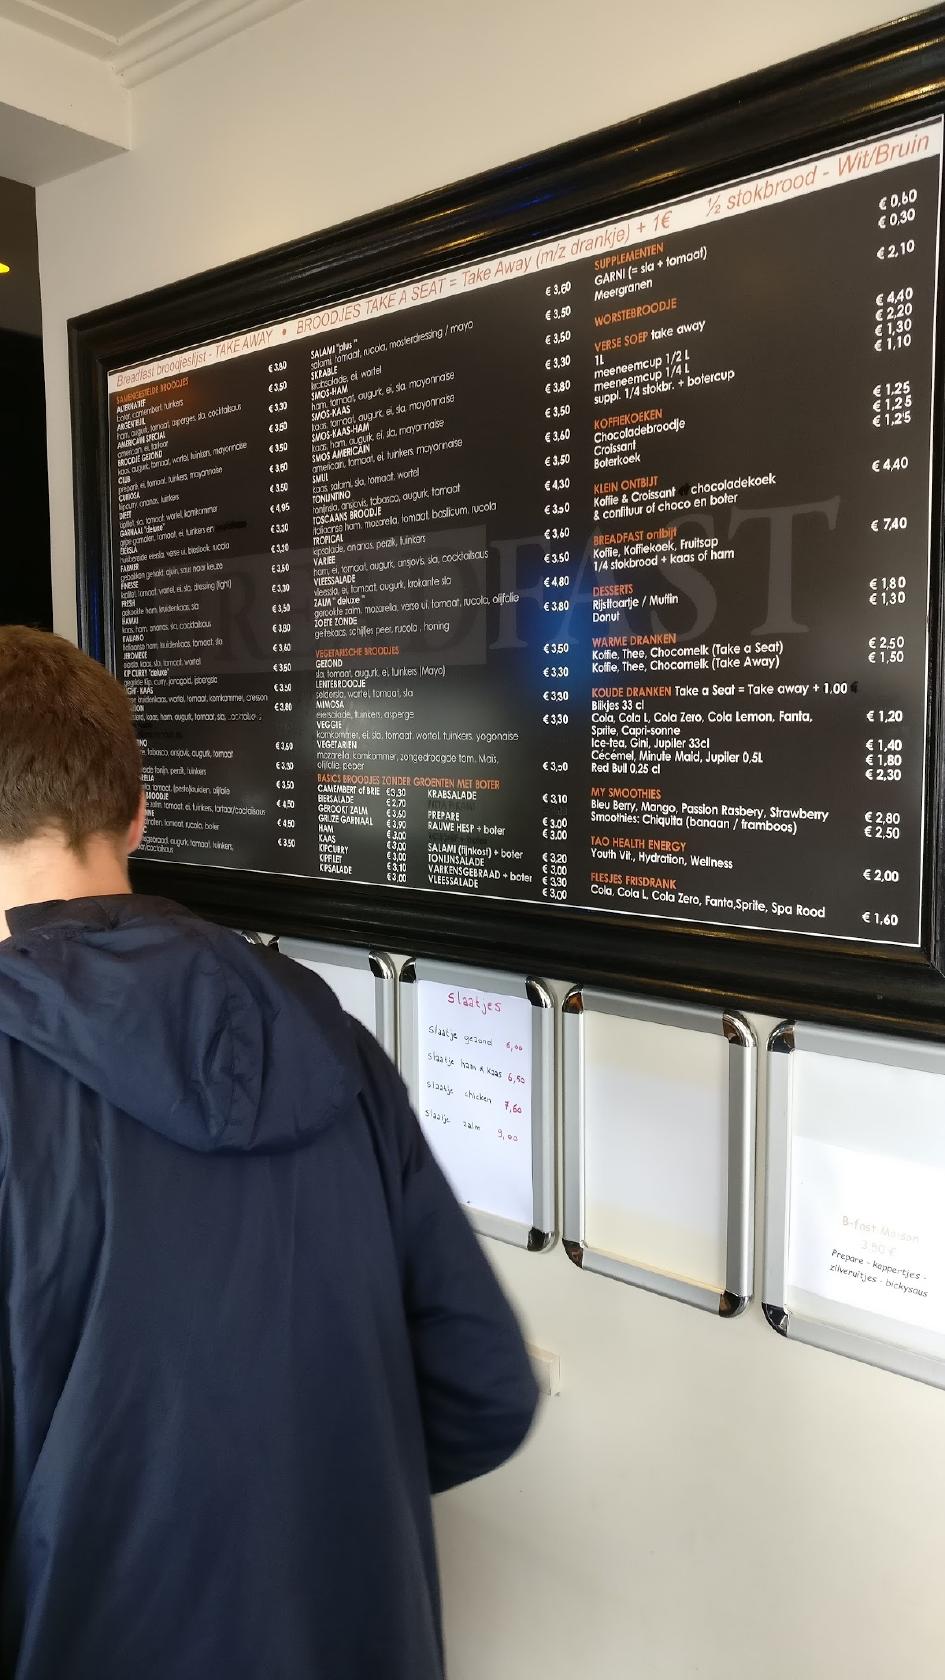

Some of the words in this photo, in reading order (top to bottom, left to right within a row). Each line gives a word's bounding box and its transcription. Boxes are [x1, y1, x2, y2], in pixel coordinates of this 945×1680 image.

[241, 328, 274, 351] AWAY
[295, 302, 362, 335] BROODJES
[364, 291, 397, 315] TAKE
[398, 289, 407, 306] A
[410, 277, 447, 302] SEAT
[461, 267, 492, 287] Take
[493, 255, 533, 278] Away
[535, 243, 567, 270] (m/z
[570, 223, 630, 256] drankje)
[653, 209, 673, 232] 1€
[726, 165, 818, 210] stokbrood
[838, 133, 929, 177] Wit/Bruin
[876, 246, 885, 260] €
[887, 239, 916, 259] 2,10
[594, 241, 664, 271] SUPPLEMENTEN
[594, 278, 653, 302] Meergranen
[875, 293, 884, 307] €
[886, 287, 914, 305] 4,40
[545, 309, 552, 321] €
[552, 305, 572, 320] 3,50
[594, 297, 677, 327] WORSTEBROODJE
[594, 337, 622, 352] VERSE
[624, 331, 649, 346] SOEP
[650, 327, 674, 341] take
[676, 320, 706, 335] away
[593, 408, 663, 430] KOFFIEKOEKEN
[593, 417, 686, 444] Chocoladebroodje
[593, 438, 637, 457] Croissant
[593, 451, 641, 470] Boterkoek
[544, 480, 551, 492] €
[551, 477, 570, 491] 4,30
[593, 481, 619, 495] KLEIN
[620, 475, 659, 491] ONTBIJT
[643, 526, 678, 548] ontbijt
[680, 537, 719, 550] Fruitsap
[591, 583, 634, 599] DESSERTS
[592, 610, 621, 623] Donut
[591, 635, 628, 648] WARME
[629, 632, 677, 646] DRANKEN
[649, 657, 710, 671] Chocomelk
[711, 656, 741, 671] (Take
[743, 654, 780, 670] Away)
[592, 687, 624, 698] KOUDE
[626, 686, 672, 697] DRANKEN
[674, 684, 699, 697] Take
[701, 686, 710, 696] a
[711, 683, 736, 696] Seat
[747, 683, 775, 695] Take
[777, 684, 810, 697] away
[591, 699, 620, 713] Blikjes
[621, 699, 633, 711] 33
[635, 699, 645, 711] cl
[866, 710, 875, 722] €
[878, 709, 904, 724] 1,20
[620, 724, 681, 738] Capri-sonne
[653, 737, 687, 751] Jupiler
[688, 737, 710, 749] 33cl
[638, 749, 672, 762] Minute
[705, 750, 740, 765] Jupiler
[742, 750, 764, 764] 0,5L
[591, 762, 610, 773] Red
[611, 762, 628, 774] Bull
[629, 762, 649, 775] 0,25
[651, 763, 661, 774] cl
[427, 789, 477, 801] KRABSALADE
[591, 787, 606, 797] MY
[608, 787, 662, 800] SMOOTHIES
[591, 799, 611, 810] Bleu
[681, 802, 719, 815] Passion
[769, 806, 829, 823] Strawberry
[864, 811, 873, 823] €
[875, 811, 901, 826] 2,80
[427, 821, 455, 832] RAUWE
[456, 823, 475, 834] HESP
[483, 824, 506, 836] boter
[590, 835, 610, 847] TAO
[612, 837, 645, 850] HEALTH
[648, 839, 687, 853] ENERGY
[590, 847, 617, 860] Youth
[690, 855, 734, 869] Wellness
[427, 874, 479, 889] VLEESSALADE
[590, 872, 623, 885] FLESJES
[625, 875, 677, 890] FRISDRANK
[862, 868, 872, 881] €
[873, 869, 899, 883] 2,00
[861, 911, 871, 924] €
[873, 912, 899, 926] 1,60
[507, 1072, 526, 1084] 6,50
[504, 1100, 522, 1114] 7,60
[831, 1248, 864, 1265] Prepare
[829, 1264, 878, 1283] zilveruitjes
[885, 1278, 929, 1298] bickysaus
